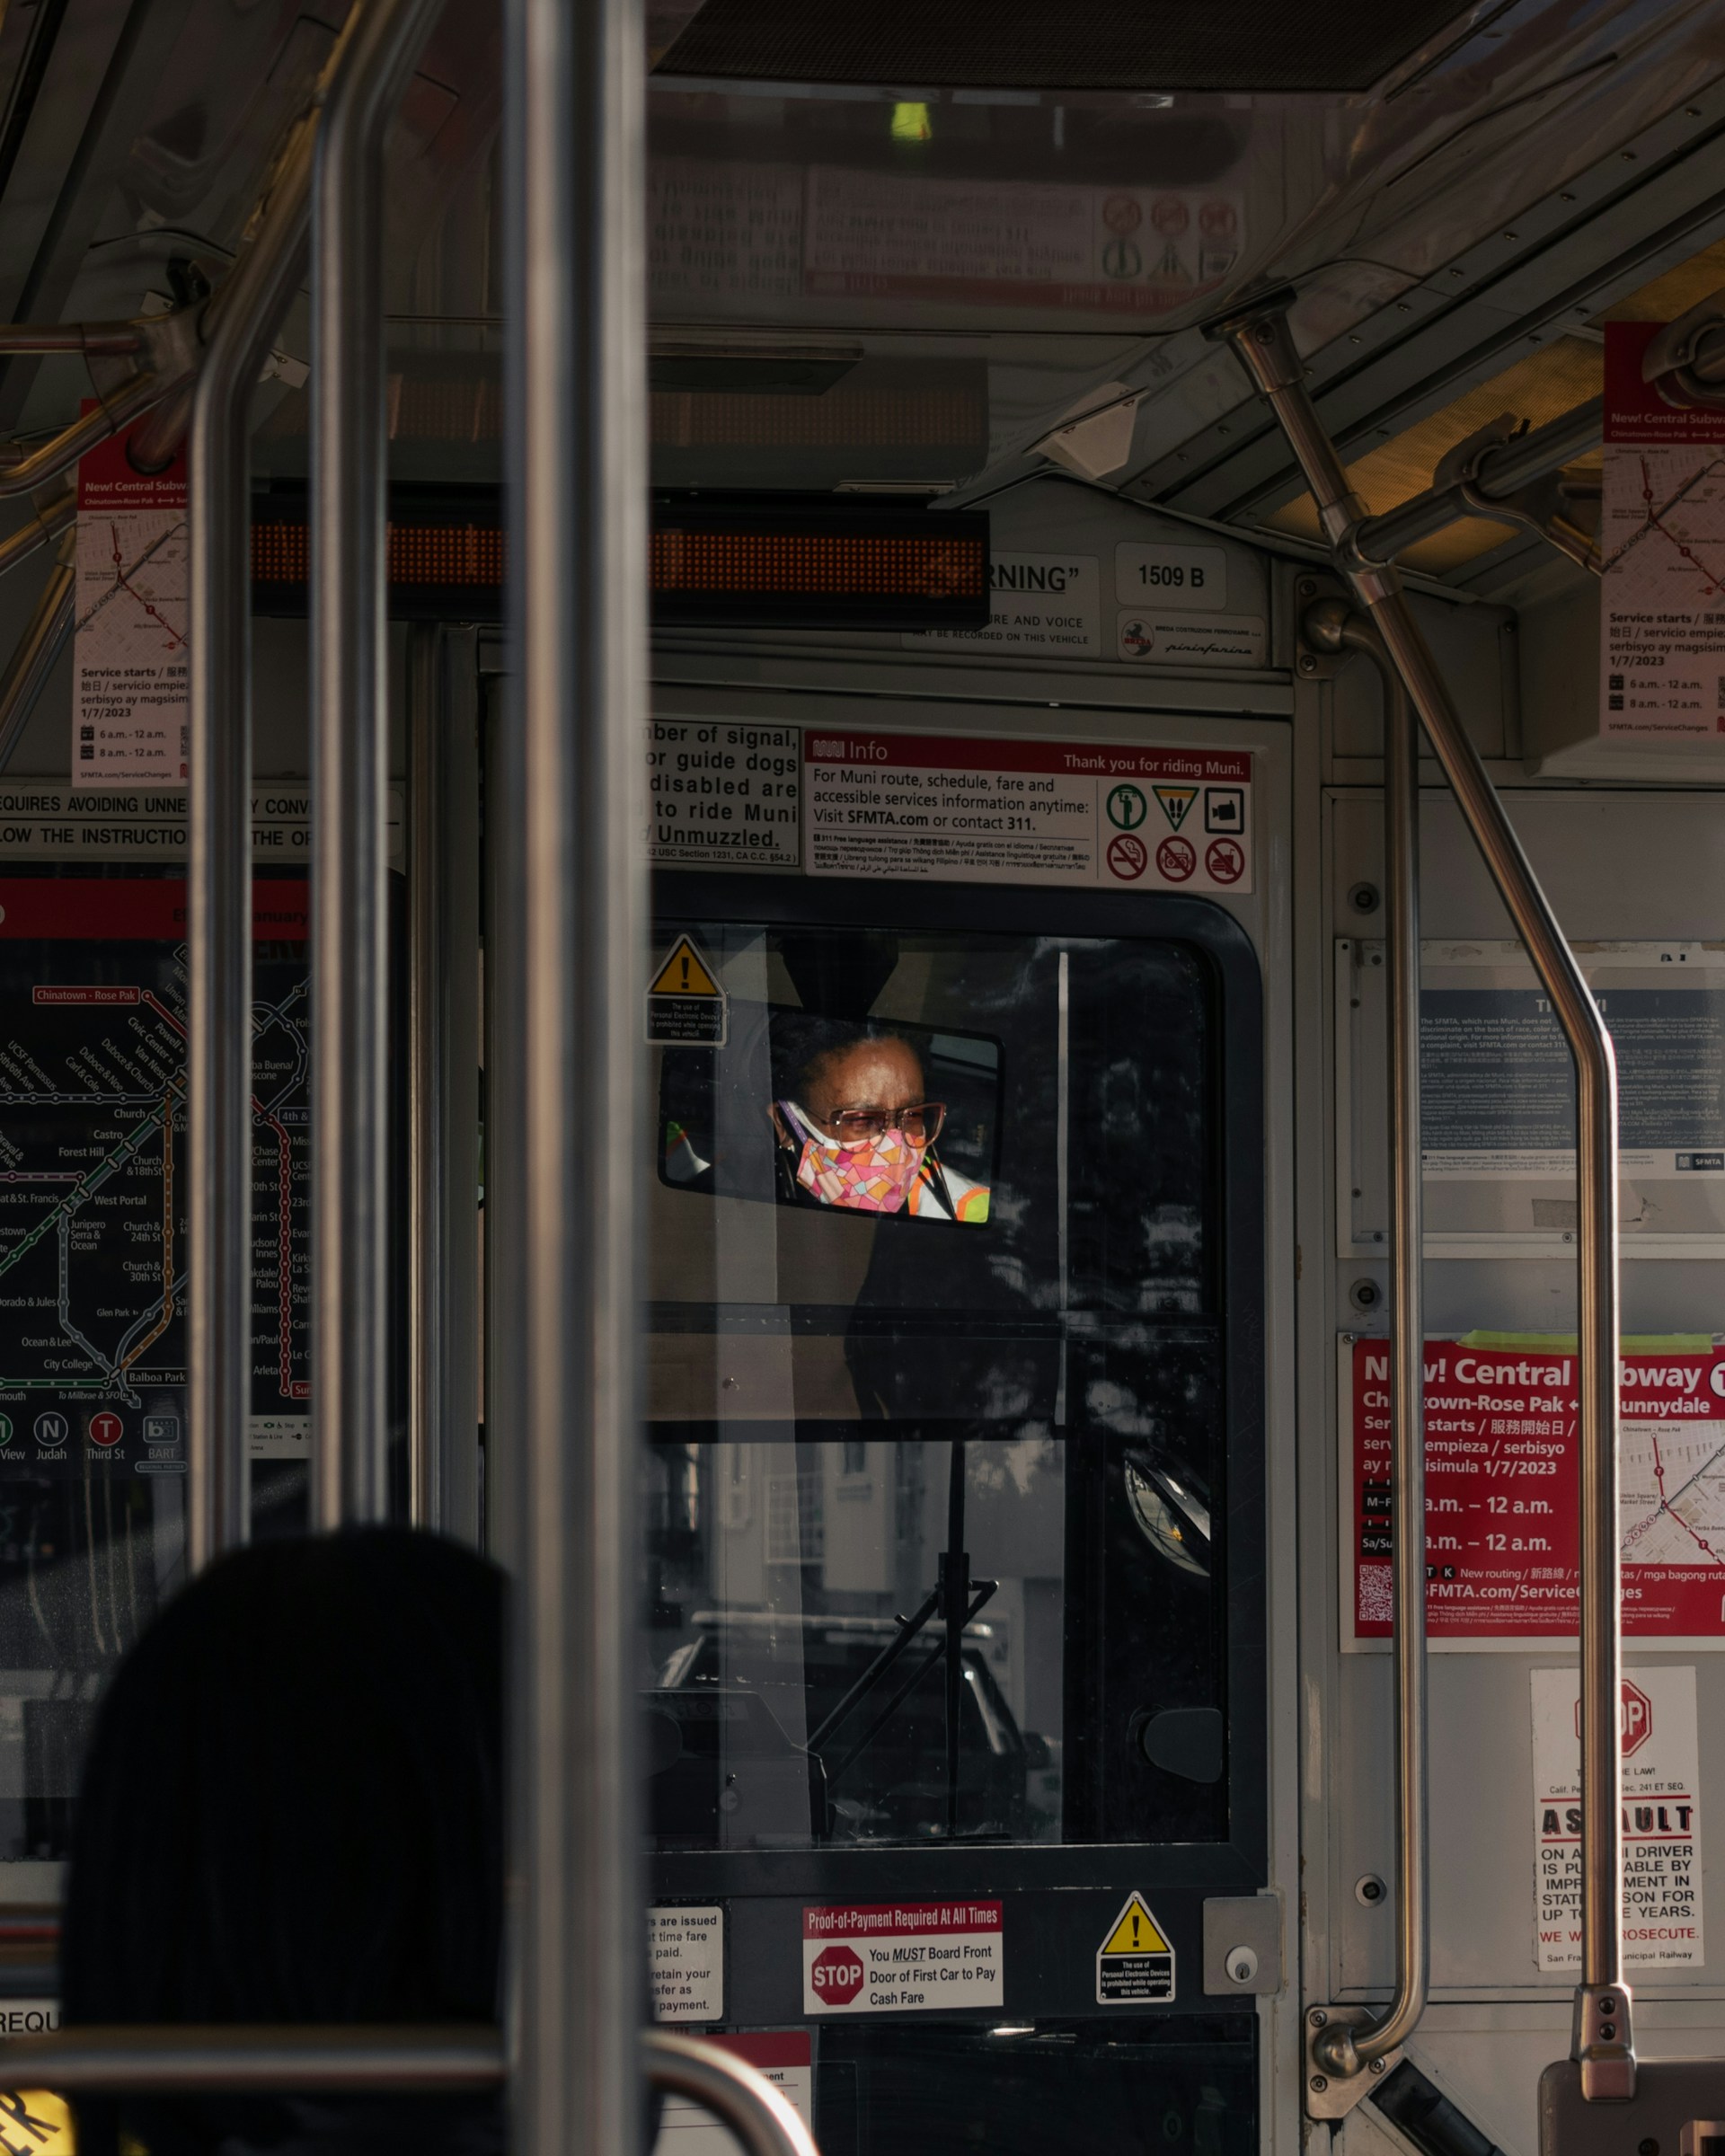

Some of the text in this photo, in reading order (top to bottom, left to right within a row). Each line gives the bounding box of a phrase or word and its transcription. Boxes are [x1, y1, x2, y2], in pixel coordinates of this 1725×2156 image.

[1611, 413, 1687, 424] New! Central
[84, 481, 154, 492] New! Central
[1138, 564, 1205, 588] 1509 B
[1013, 615, 1041, 626] AND
[1046, 616, 1084, 628] VOICE
[1609, 613, 1692, 624] Service starts
[952, 632, 1089, 645] RECORDED ON THIS VEHICLE
[1610, 656, 1665, 667] 1/7/2023
[81, 667, 156, 677] Service starts
[81, 706, 132, 719] 1/7/2023
[1608, 723, 1709, 733] SFMTA.com/ServiceChanges
[697, 725, 797, 750] of signal,
[849, 740, 889, 761] Info
[677, 750, 797, 776] guide dogs
[1063, 753, 1245, 777] Thank you for riding Muni.
[80, 770, 172, 780] SFMTA.com/ServiceChanges
[813, 768, 1055, 793] For Muni route, schedule, fare and
[650, 773, 797, 798] disabled are
[67, 797, 138, 813] AVOIDING
[813, 790, 1090, 816] accessible services information anytime:
[655, 800, 797, 823] to ride Muni
[813, 808, 1037, 832] Visit SFMTA.com or contact 311.
[40, 828, 75, 844] THE
[658, 824, 780, 847] Unmuzzled.
[834, 835, 908, 845] Free language assistance
[955, 839, 976, 849] Ayuda
[678, 849, 710, 859] Section
[36, 990, 137, 1001] Chinatown Rose Pak
[1461, 1018, 1482, 1026] which
[154, 1021, 182, 1050] Powell
[7, 1038, 28, 1062] UCSF
[144, 1032, 171, 1060] Center
[129, 1065, 155, 1092] Church
[113, 1108, 146, 1119] Church
[93, 1129, 124, 1141] Castro
[58, 1146, 105, 1158] Forest Hill
[131, 1155, 163, 1166] Church
[1694, 1157, 1721, 1166] SFMTA
[93, 1195, 147, 1206] West Portal
[70, 1219, 106, 1231] Junipero
[70, 1230, 93, 1241] Serra
[70, 1241, 98, 1250] Ocean
[21, 1337, 49, 1348] Ocean
[43, 1358, 93, 1373] City College
[128, 1372, 186, 1383] Balboa Park
[1364, 1355, 1703, 1394] Nw! Central bway
[1528, 1395, 1712, 1418] Pak unnydale
[42, 1419, 59, 1438] N
[98, 1419, 113, 1438] T
[1427, 1418, 1476, 1433] starts
[1490, 1419, 1565, 1436] 服務開始日
[35, 1448, 67, 1460] Judah
[86, 1447, 112, 1460] Third
[148, 1447, 176, 1460] BART
[1503, 1440, 1566, 1458] serbisyo
[1362, 1460, 1558, 1479] ay 1/7/2023
[1486, 1496, 1554, 1515] 12 a.m.
[1362, 1537, 1393, 1551] Sa/Su
[1484, 1533, 1552, 1552] 12 a.m.
[1460, 1568, 1522, 1581] New routing
[1530, 1567, 1565, 1580] 新路線
[1668, 1569, 1706, 1583] bagong
[1633, 1766, 1656, 1778] LAW!
[1639, 1781, 1686, 1792] 241 ET SEQ.
[1541, 1806, 1694, 1835] ASULT
[1541, 1848, 1565, 1861] ON
[1635, 1845, 1694, 1859] DRIVER
[1543, 1860, 1692, 1876] IS BY
[1675, 1875, 1690, 1887] IN
[1662, 1890, 1695, 1904] FOR
[808, 1905, 998, 1931] Proof-of-Payment Required At All Times
[1542, 1905, 1696, 1922] UP YEARS.
[659, 1915, 718, 1927] are issued
[659, 1931, 708, 1942] time fare
[1539, 1931, 1562, 1943] WE
[655, 1947, 684, 1960] paid.
[869, 1945, 993, 1962] You MUST Board Front
[1546, 1953, 1564, 1964] San
[1659, 1949, 1694, 1961] Railway
[686, 1970, 712, 1982] your
[813, 1964, 862, 1988] STOP
[869, 1966, 996, 1984] Door of First Car to Pay
[1124, 1970, 1150, 1978] Electronic
[1106, 1979, 1132, 1988] prohibited
[679, 1986, 693, 1995] as
[869, 1991, 925, 2006] Cash Fare
[659, 1999, 710, 2013] payment.
